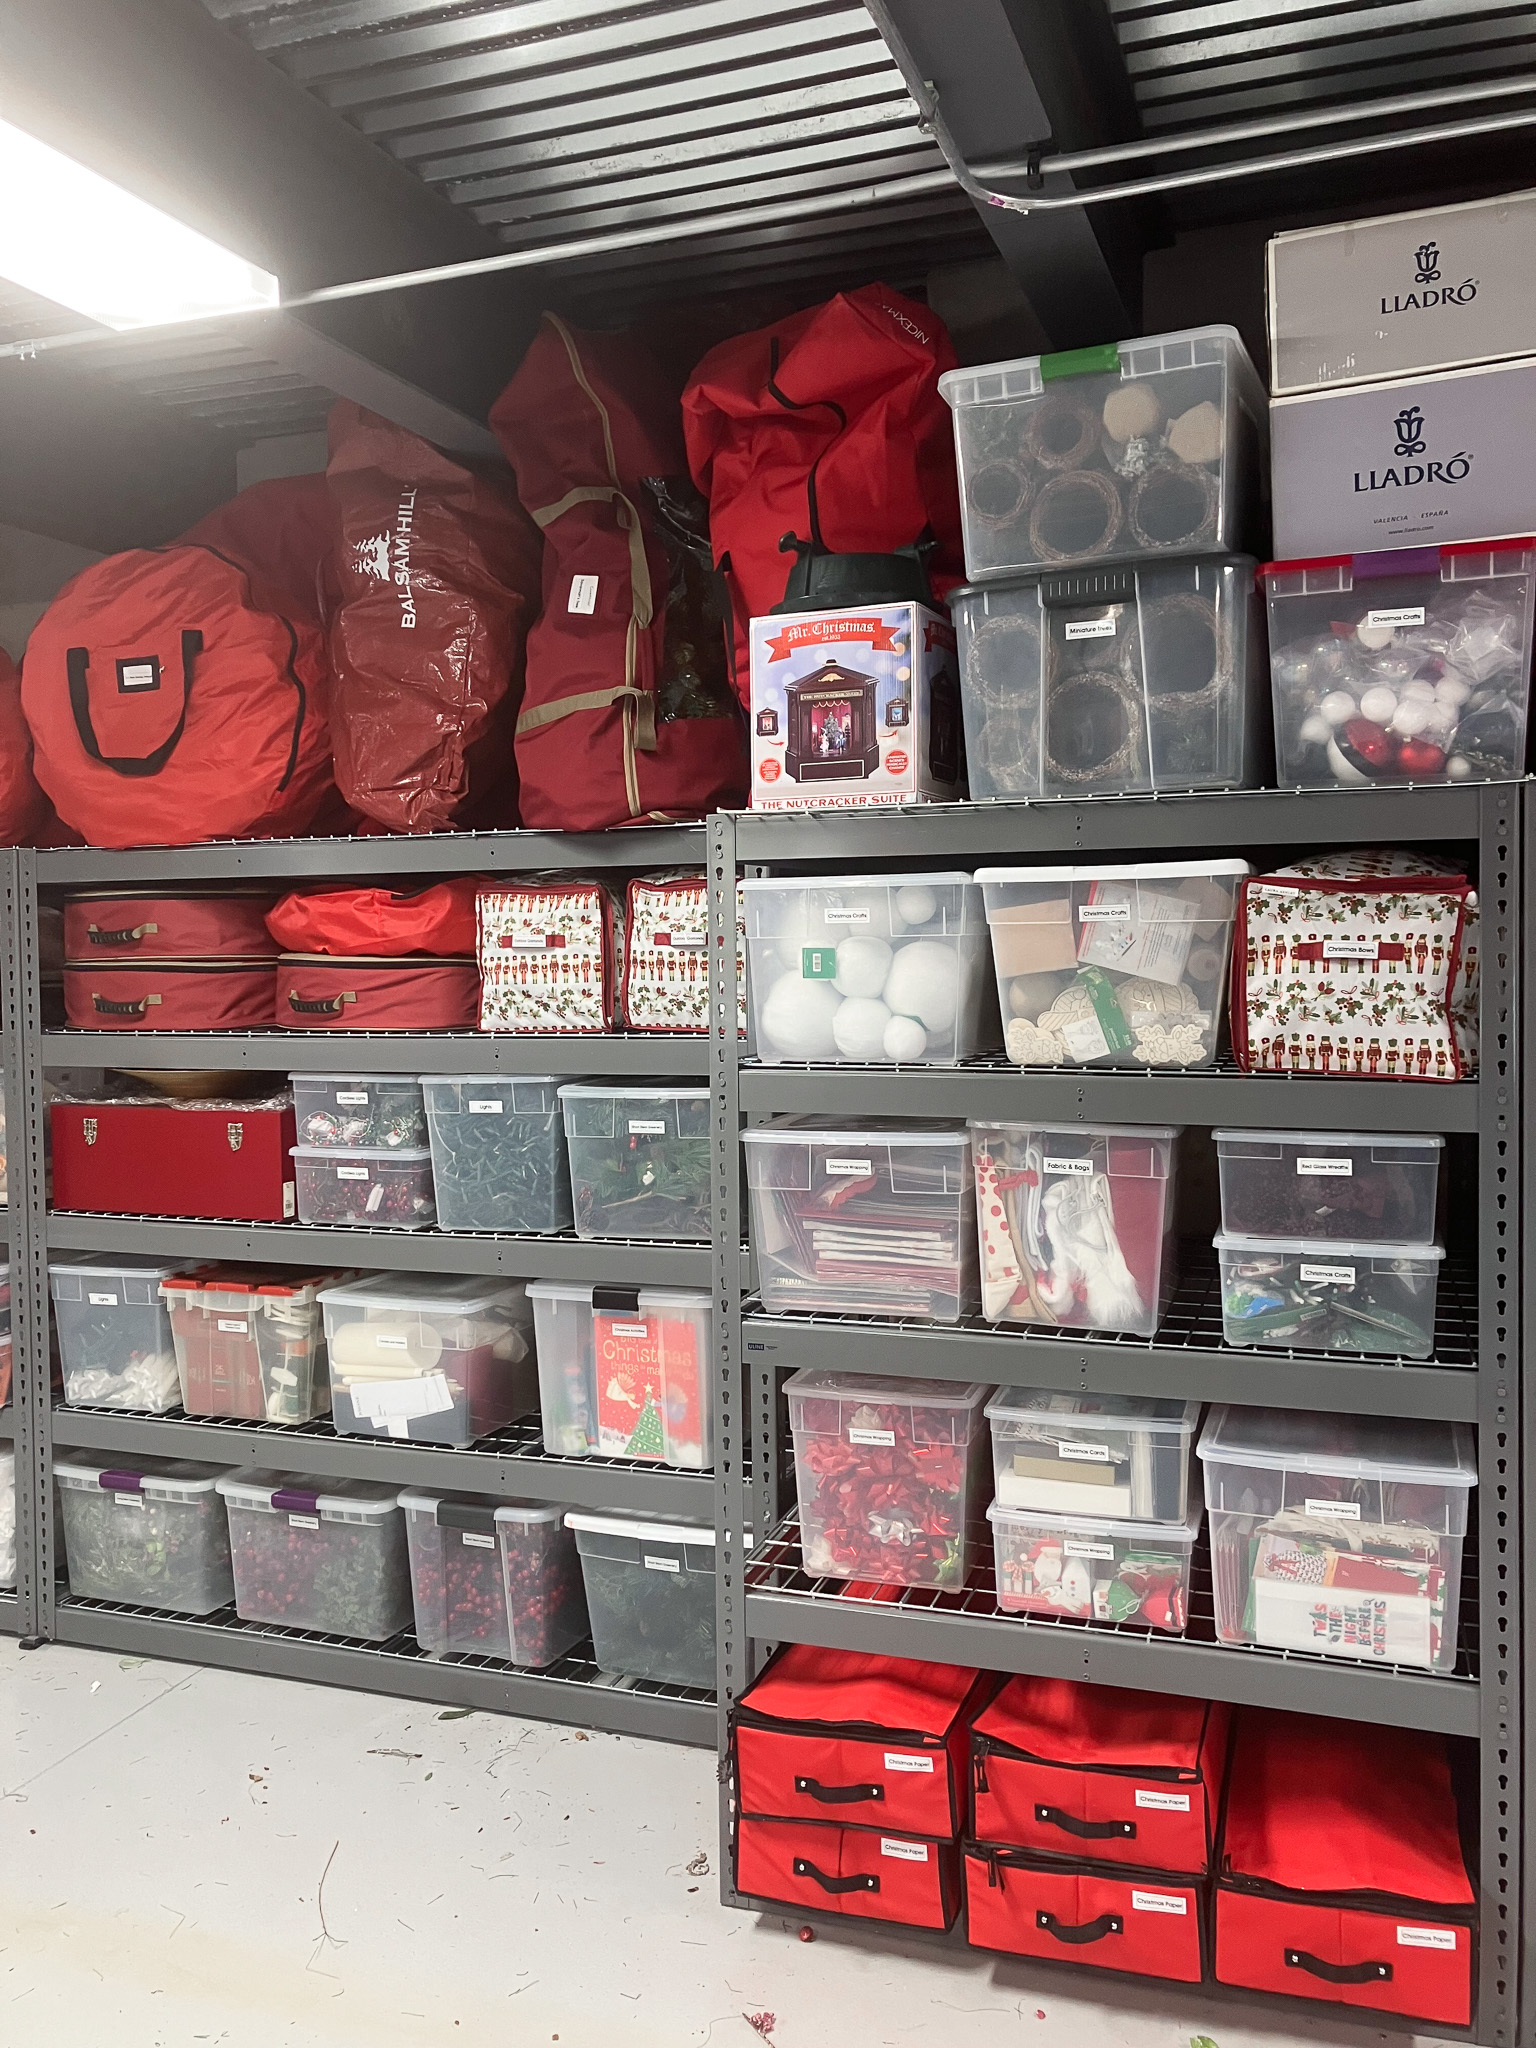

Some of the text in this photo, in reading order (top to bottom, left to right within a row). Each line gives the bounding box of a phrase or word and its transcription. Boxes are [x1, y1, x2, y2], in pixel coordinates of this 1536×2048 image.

[1381, 278, 1477, 314] LLADRÓ
[1354, 451, 1470, 492] LLADRÓ
[1373, 510, 1449, 524] VALENCIA ESPAÑA
[394, 488, 417, 628] BALSAM HILL
[1372, 613, 1421, 623] Christmas Crafts
[788, 625, 811, 642] Mr.
[761, 794, 907, 809] THE NUTCRACKER SUITE
[828, 911, 851, 919] Christmas
[1048, 1162, 1066, 1170] Fabric
[1074, 1164, 1090, 1172] Bags
[1063, 1447, 1088, 1455] Christmas
[1068, 1545, 1088, 1553] Christmas
[1344, 1606, 1357, 1644] NIGHT
[1373, 1601, 1386, 1656] CHRISTMAS
[889, 1758, 913, 1766] Christmas
[1140, 1796, 1168, 1804] Christmas
[885, 1844, 908, 1853] Christmas
[1137, 1898, 1165, 1906] Christmas
[1402, 1932, 1452, 1943] Christmas Paper
